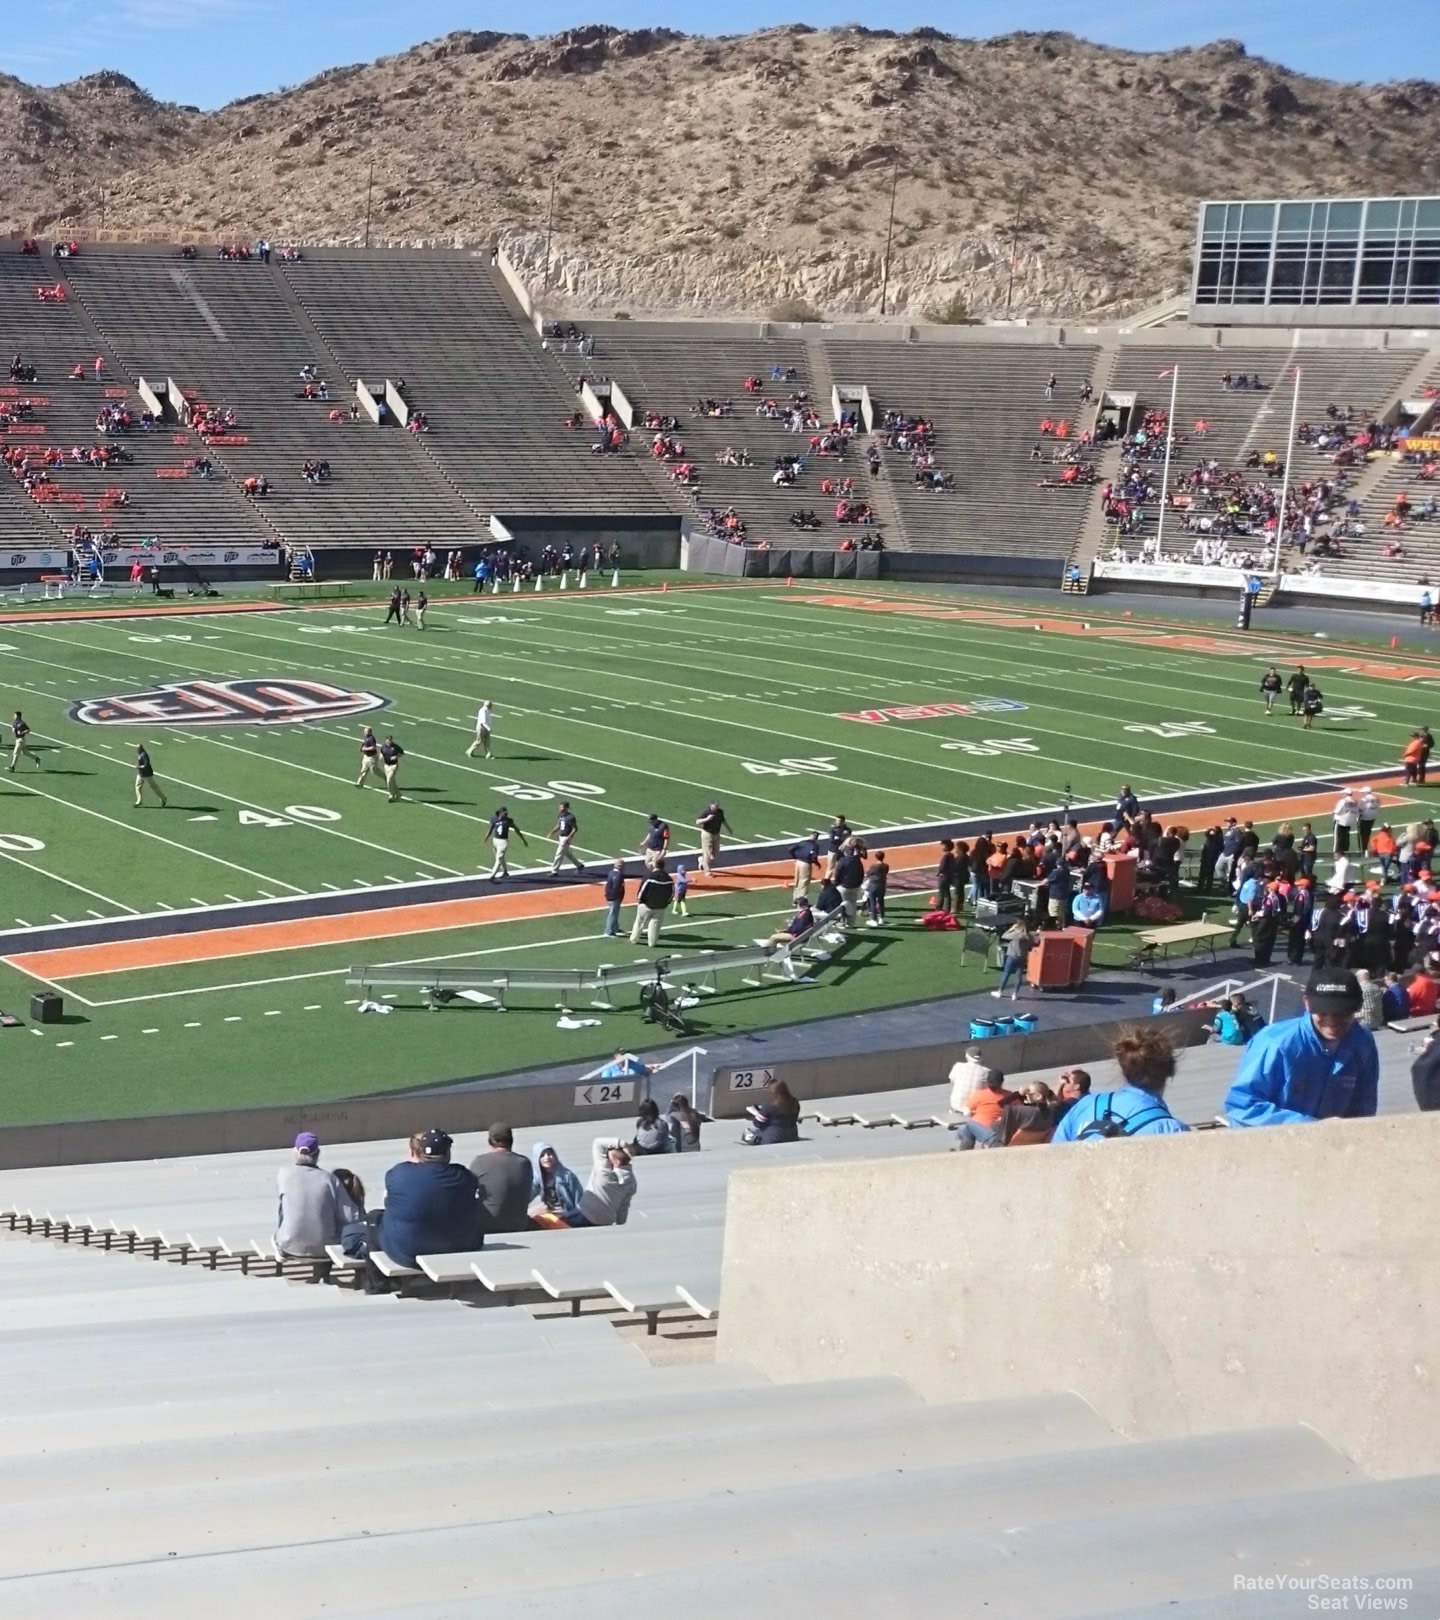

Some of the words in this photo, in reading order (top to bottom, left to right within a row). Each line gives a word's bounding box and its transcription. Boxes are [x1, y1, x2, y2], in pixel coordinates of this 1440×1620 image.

[1122, 722, 1216, 738] 20
[940, 738, 1040, 756] 30
[741, 758, 839, 777] 40
[489, 780, 607, 801] 50
[238, 805, 343, 828] 40
[496, 825, 503, 835] 4
[734, 1072, 753, 1089] 23
[600, 1085, 622, 1102] 24
